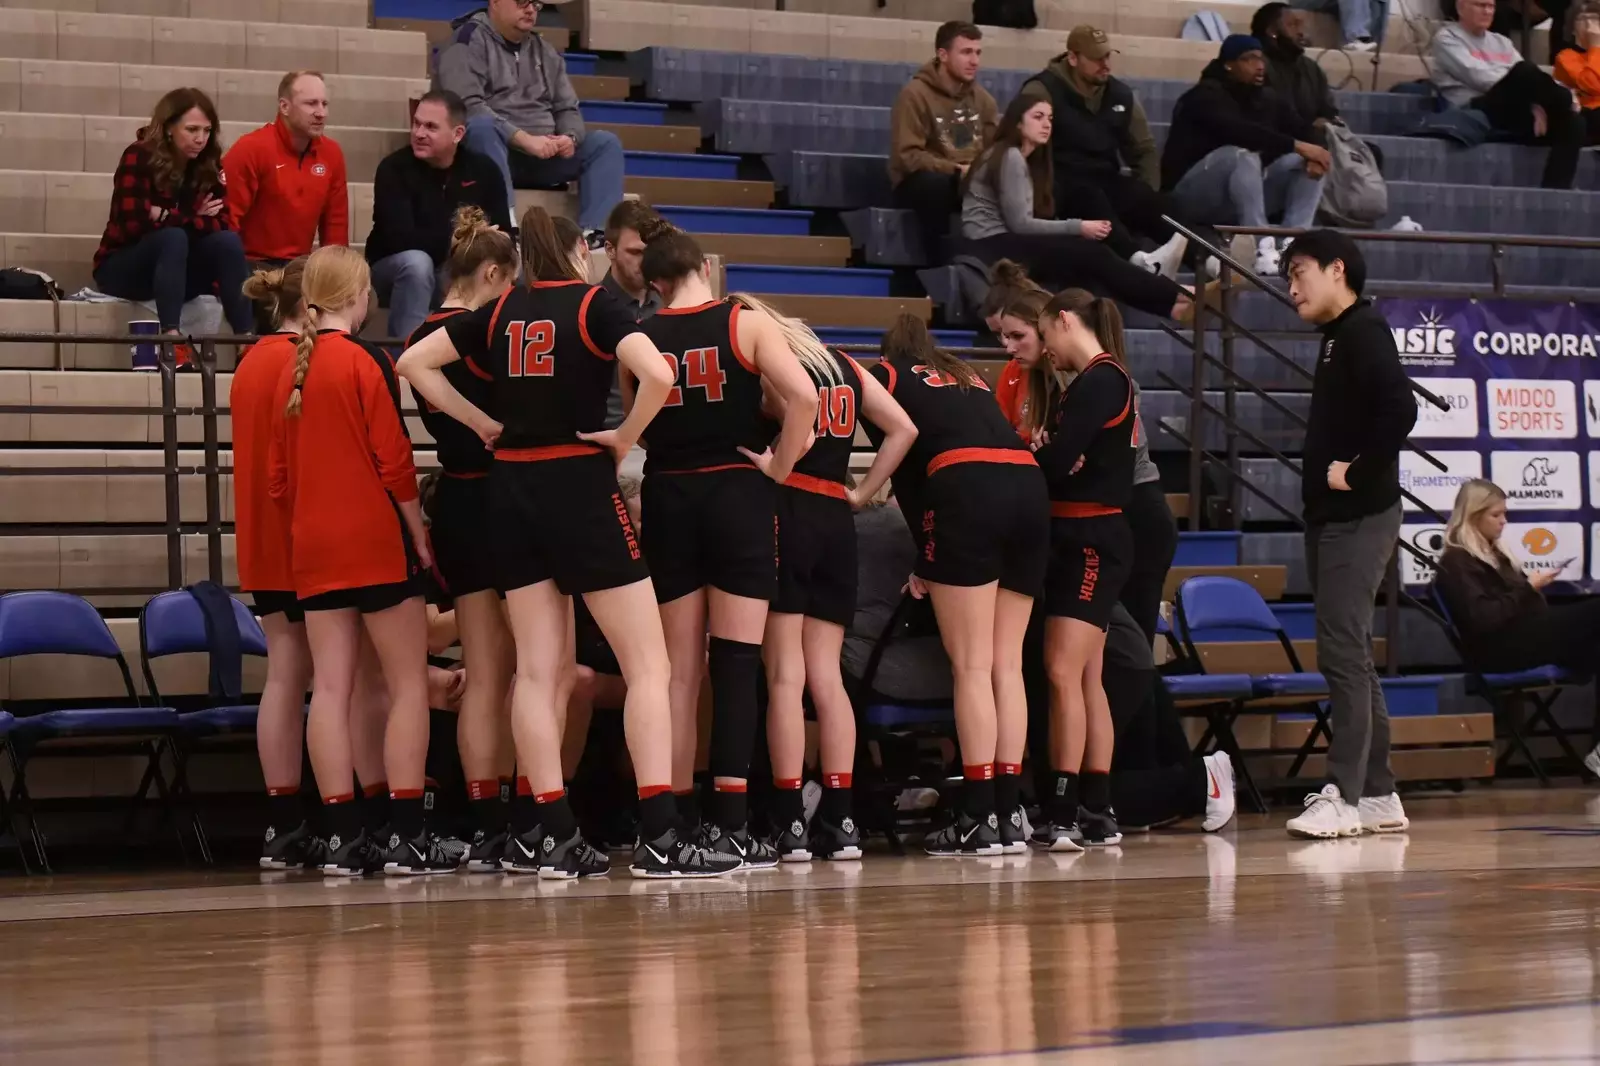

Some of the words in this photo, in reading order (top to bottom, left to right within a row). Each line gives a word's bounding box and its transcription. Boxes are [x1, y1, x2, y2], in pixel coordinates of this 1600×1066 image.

[505, 320, 556, 377] 12
[1390, 328, 1456, 354] NSIC
[1496, 387, 1556, 408] MIDCO
[815, 384, 856, 438] 10
[1497, 411, 1564, 430] SPORTS
[1508, 489, 1564, 499] MAMMOTH
[611, 493, 641, 560] HUSKIES
